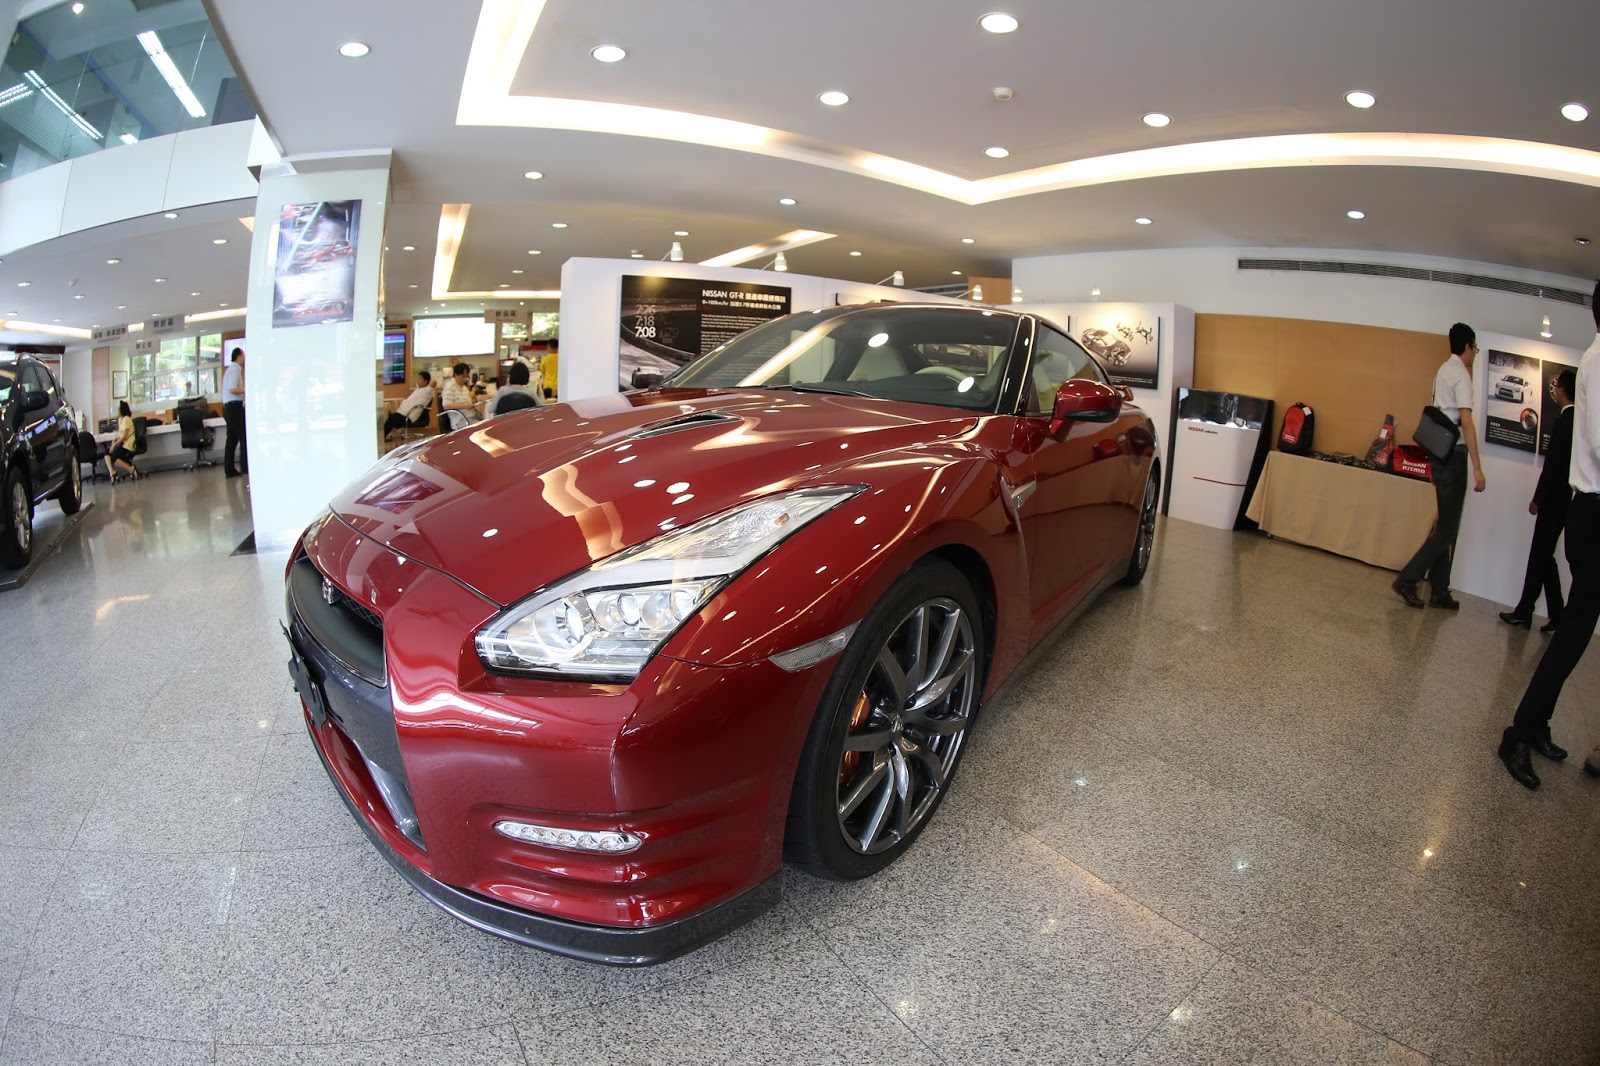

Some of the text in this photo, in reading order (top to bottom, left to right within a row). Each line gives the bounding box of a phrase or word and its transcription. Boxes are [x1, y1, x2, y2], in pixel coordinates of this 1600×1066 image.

[702, 289, 728, 298] NISSAN
[729, 291, 744, 299] GT-R
[635, 315, 655, 326] 7:18
[634, 326, 656, 338] 7:08
